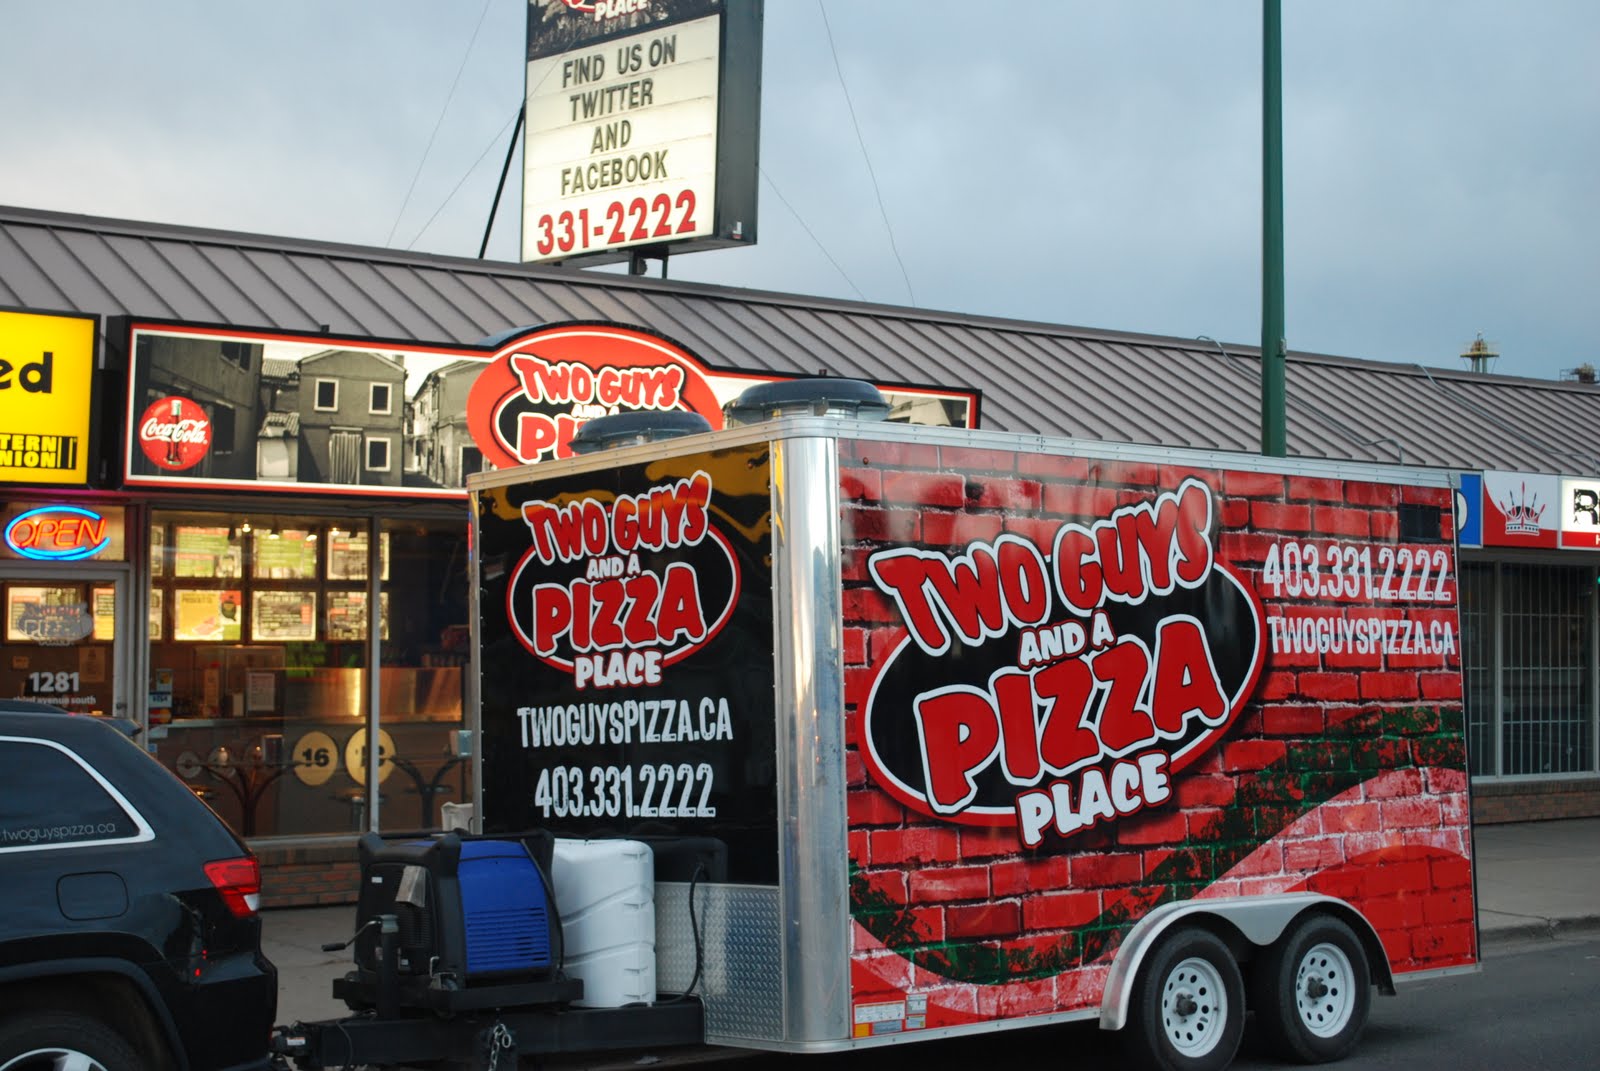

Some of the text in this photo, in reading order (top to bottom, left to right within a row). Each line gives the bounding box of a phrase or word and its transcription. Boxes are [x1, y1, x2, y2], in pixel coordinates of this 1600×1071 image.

[562, 34, 676, 88] FIND US ON
[569, 78, 653, 121] TWITTER
[590, 120, 631, 154] AND
[561, 149, 668, 196] FACEBOOK
[537, 189, 696, 256] 331-2222
[511, 353, 685, 411] TWO GUYS
[141, 417, 208, 443] Coca-Cola
[571, 403, 606, 418] AND
[9, 518, 106, 547] OPEN
[521, 470, 712, 566] TWO GUYS
[586, 552, 642, 581] AND A
[867, 475, 1214, 656] TWO GUYS
[1263, 541, 1451, 601] 403.331.2222
[533, 562, 709, 657] PIZZA
[1018, 609, 1117, 669] AND A
[1266, 616, 1455, 655] TWOGUYSPIZZA.CA
[29, 671, 80, 692] 1281
[574, 650, 662, 690] PLACE
[71, 694, 96, 705] south
[517, 697, 733, 748] TWOGUYSPIZZA.CA
[914, 614, 1231, 813] PIZZA
[302, 748, 329, 767] 16
[535, 763, 716, 818] 403.331.2222
[1016, 750, 1171, 848] PLACE
